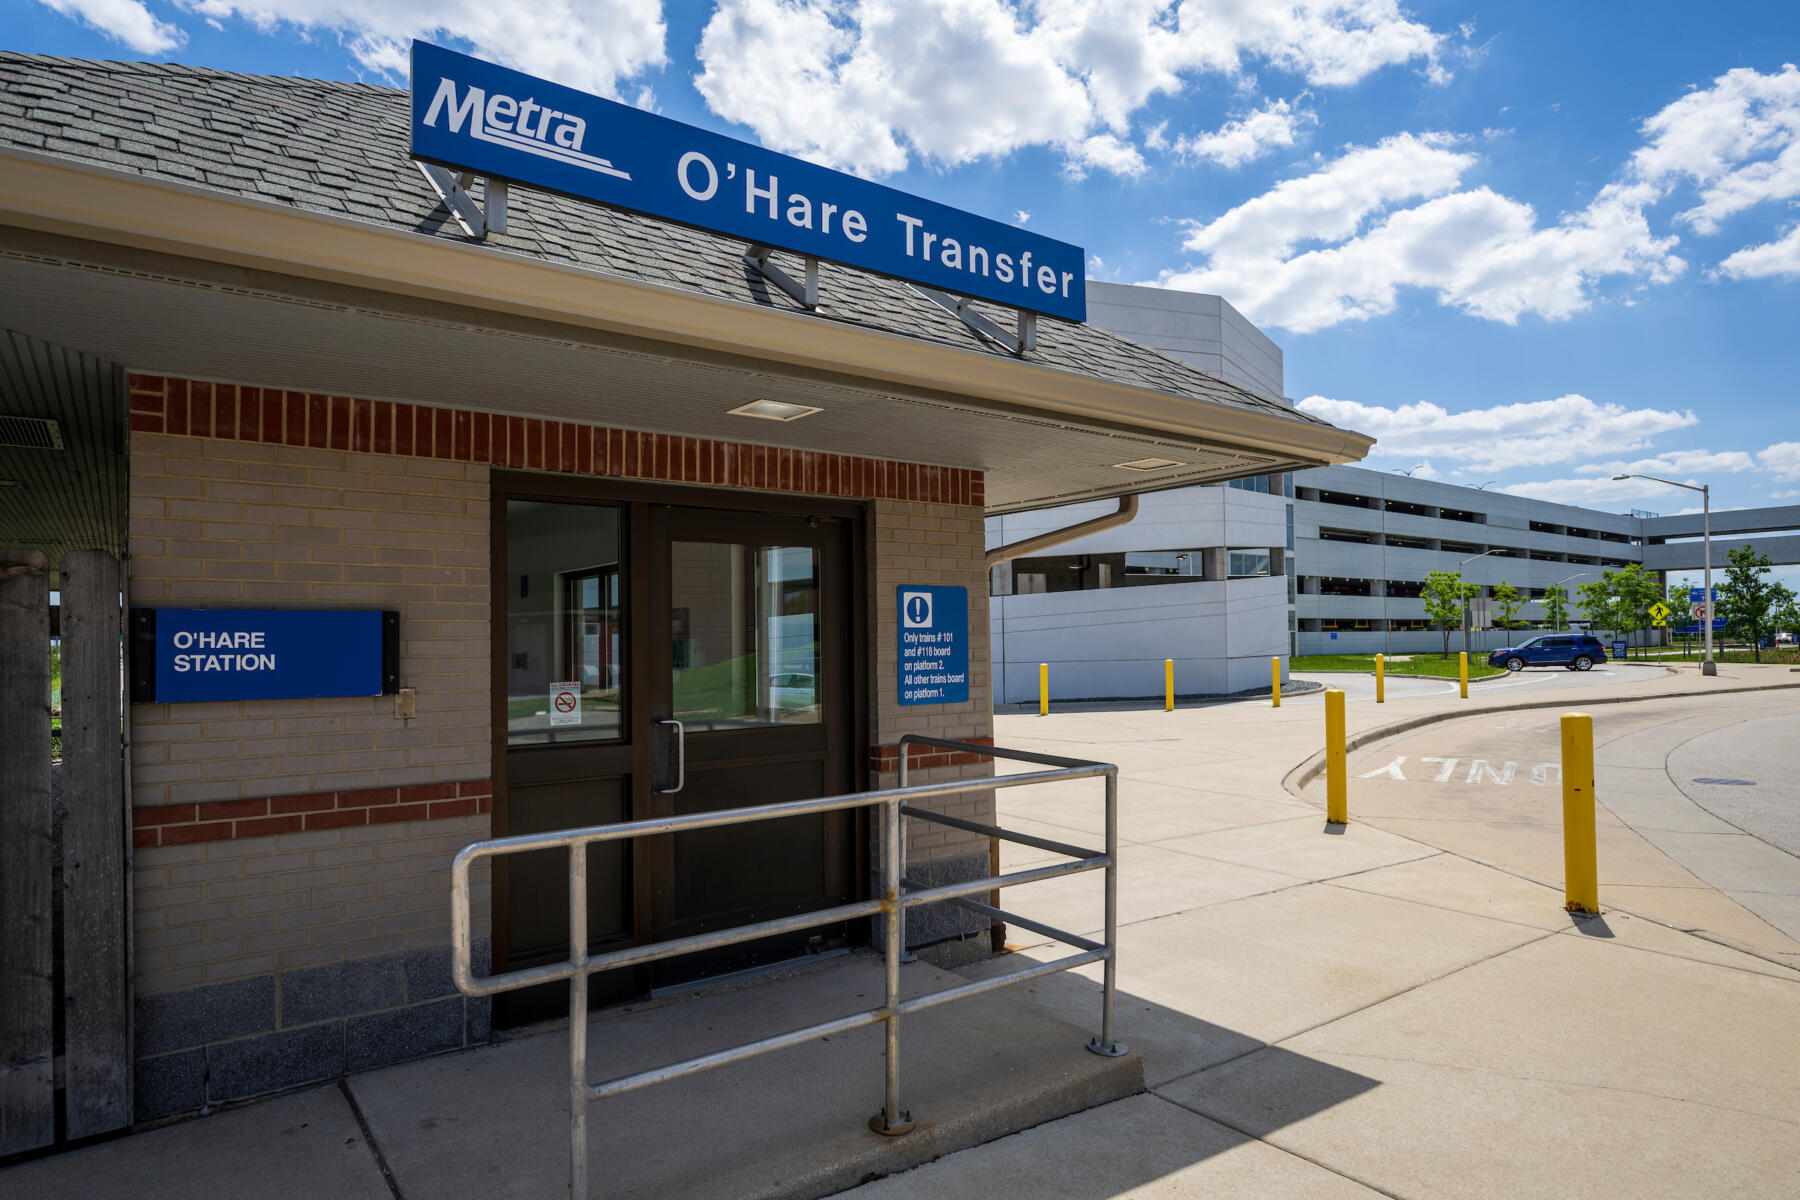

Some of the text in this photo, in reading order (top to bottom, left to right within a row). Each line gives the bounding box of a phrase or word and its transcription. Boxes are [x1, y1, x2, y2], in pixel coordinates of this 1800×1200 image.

[423, 77, 587, 152] Metra
[896, 212, 1074, 299] Transfer
[173, 631, 265, 649] O'HARE
[904, 632, 918, 645] Only
[919, 632, 936, 643] trains
[943, 632, 953, 643] 101
[904, 645, 951, 657] and #118 board
[173, 654, 276, 672] STATION
[904, 660, 945, 673] on platform 2.
[904, 672, 965, 685] All other trains board
[904, 688, 945, 701] on platform 1.
